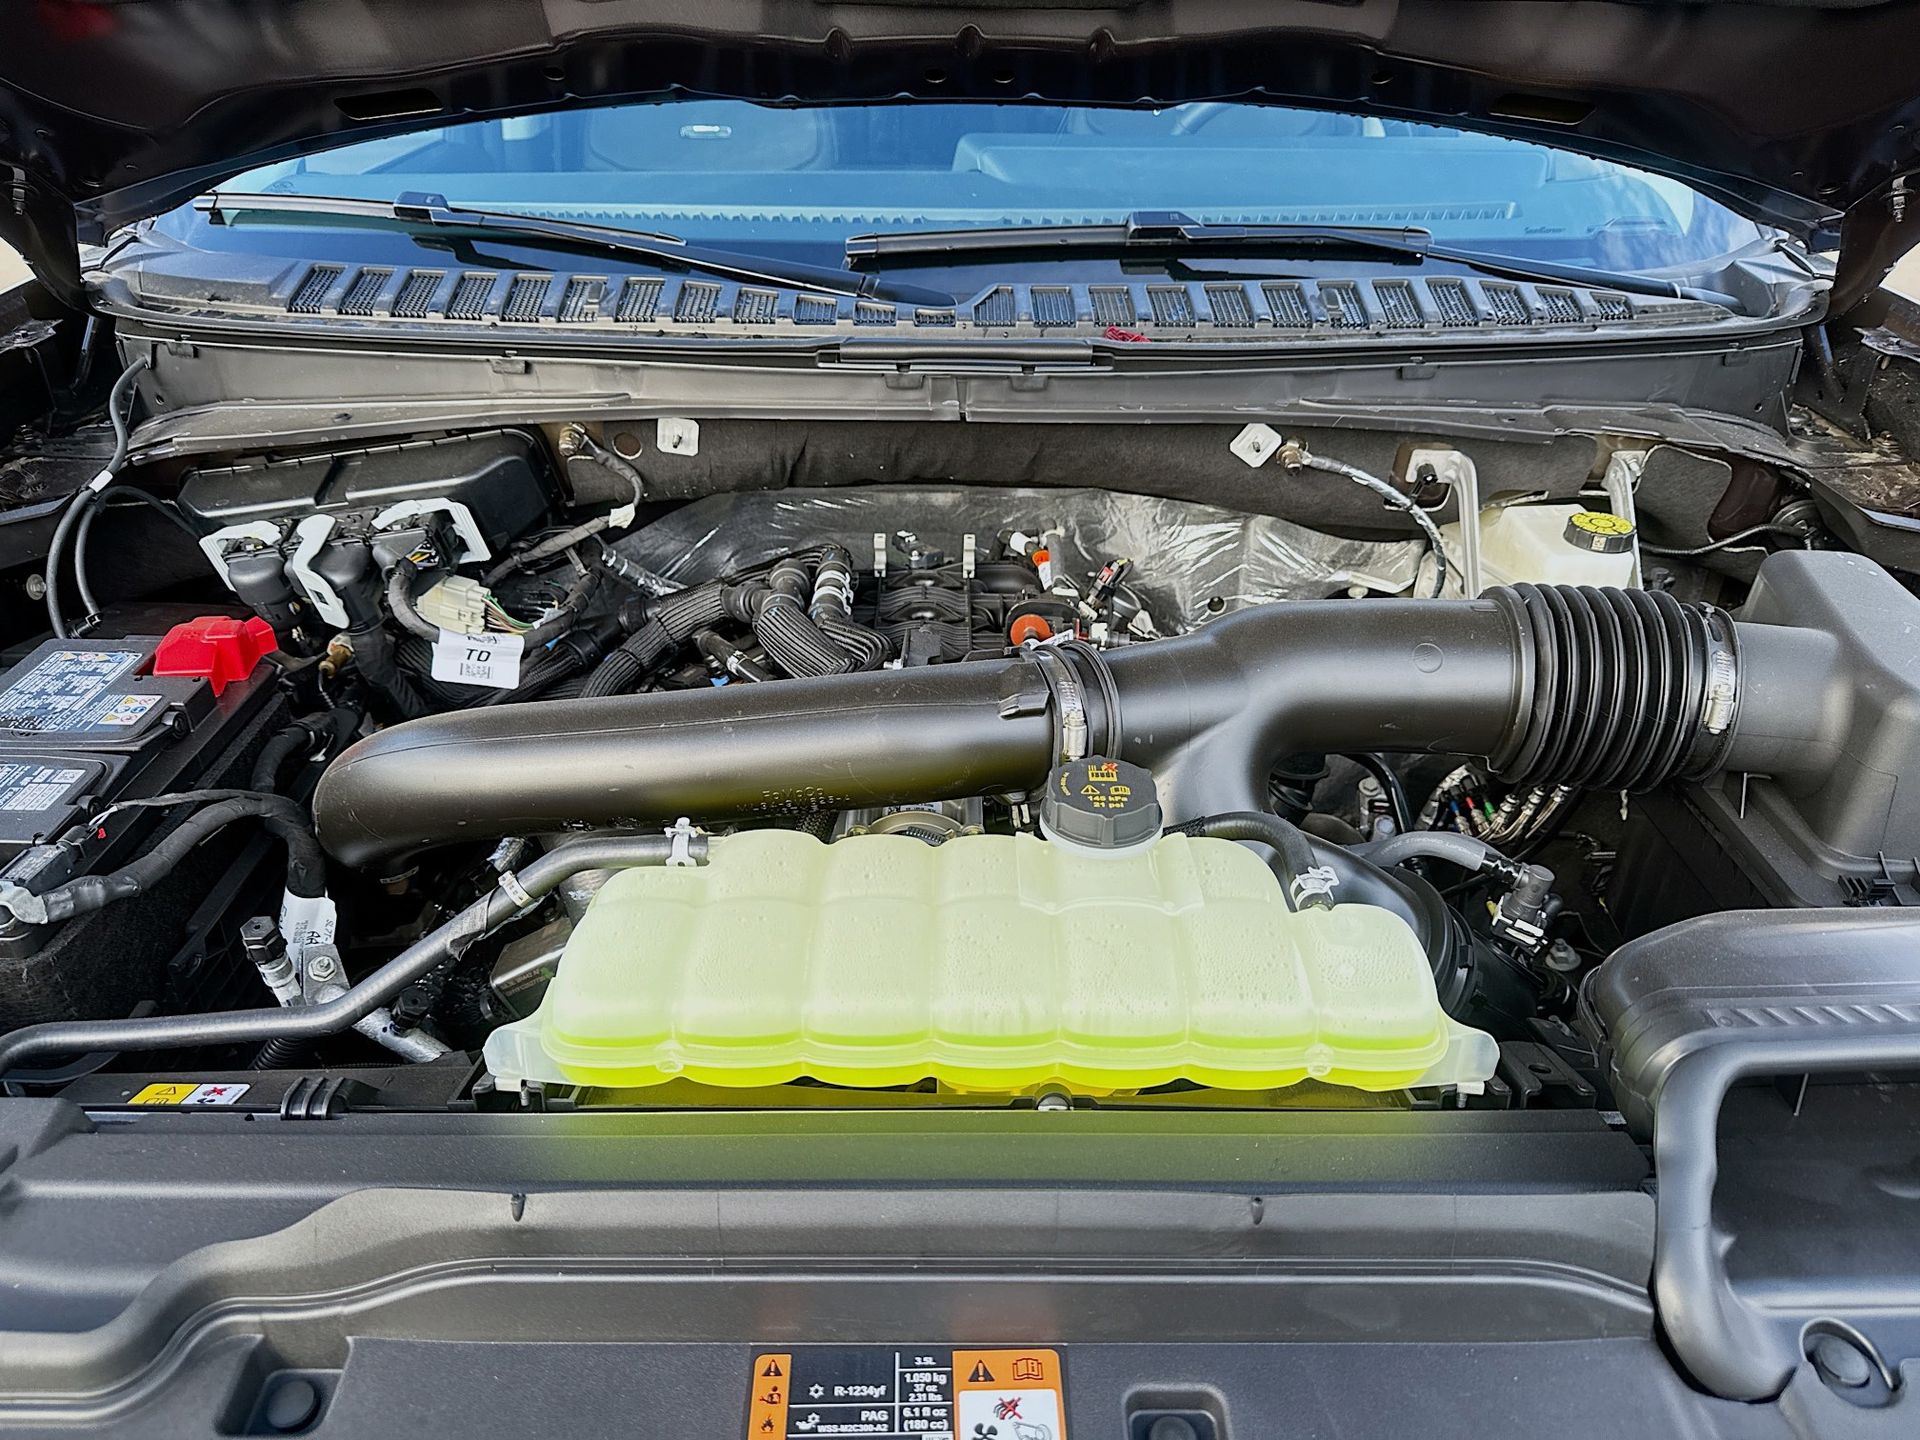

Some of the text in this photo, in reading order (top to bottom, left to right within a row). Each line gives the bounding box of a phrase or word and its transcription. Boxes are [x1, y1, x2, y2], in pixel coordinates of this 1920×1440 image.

[466, 648, 491, 662] TD
[914, 1356, 937, 1366] 3.5L
[904, 1372, 947, 1385] 1.050 kg
[833, 1385, 887, 1398] R-1234yf
[913, 1383, 925, 1392] 37
[908, 1393, 943, 1402] 2.31 lbs
[860, 1410, 889, 1421] PAG
[902, 1406, 948, 1417] 6.1 fl oz
[903, 1419, 949, 1432] (180 cc)
